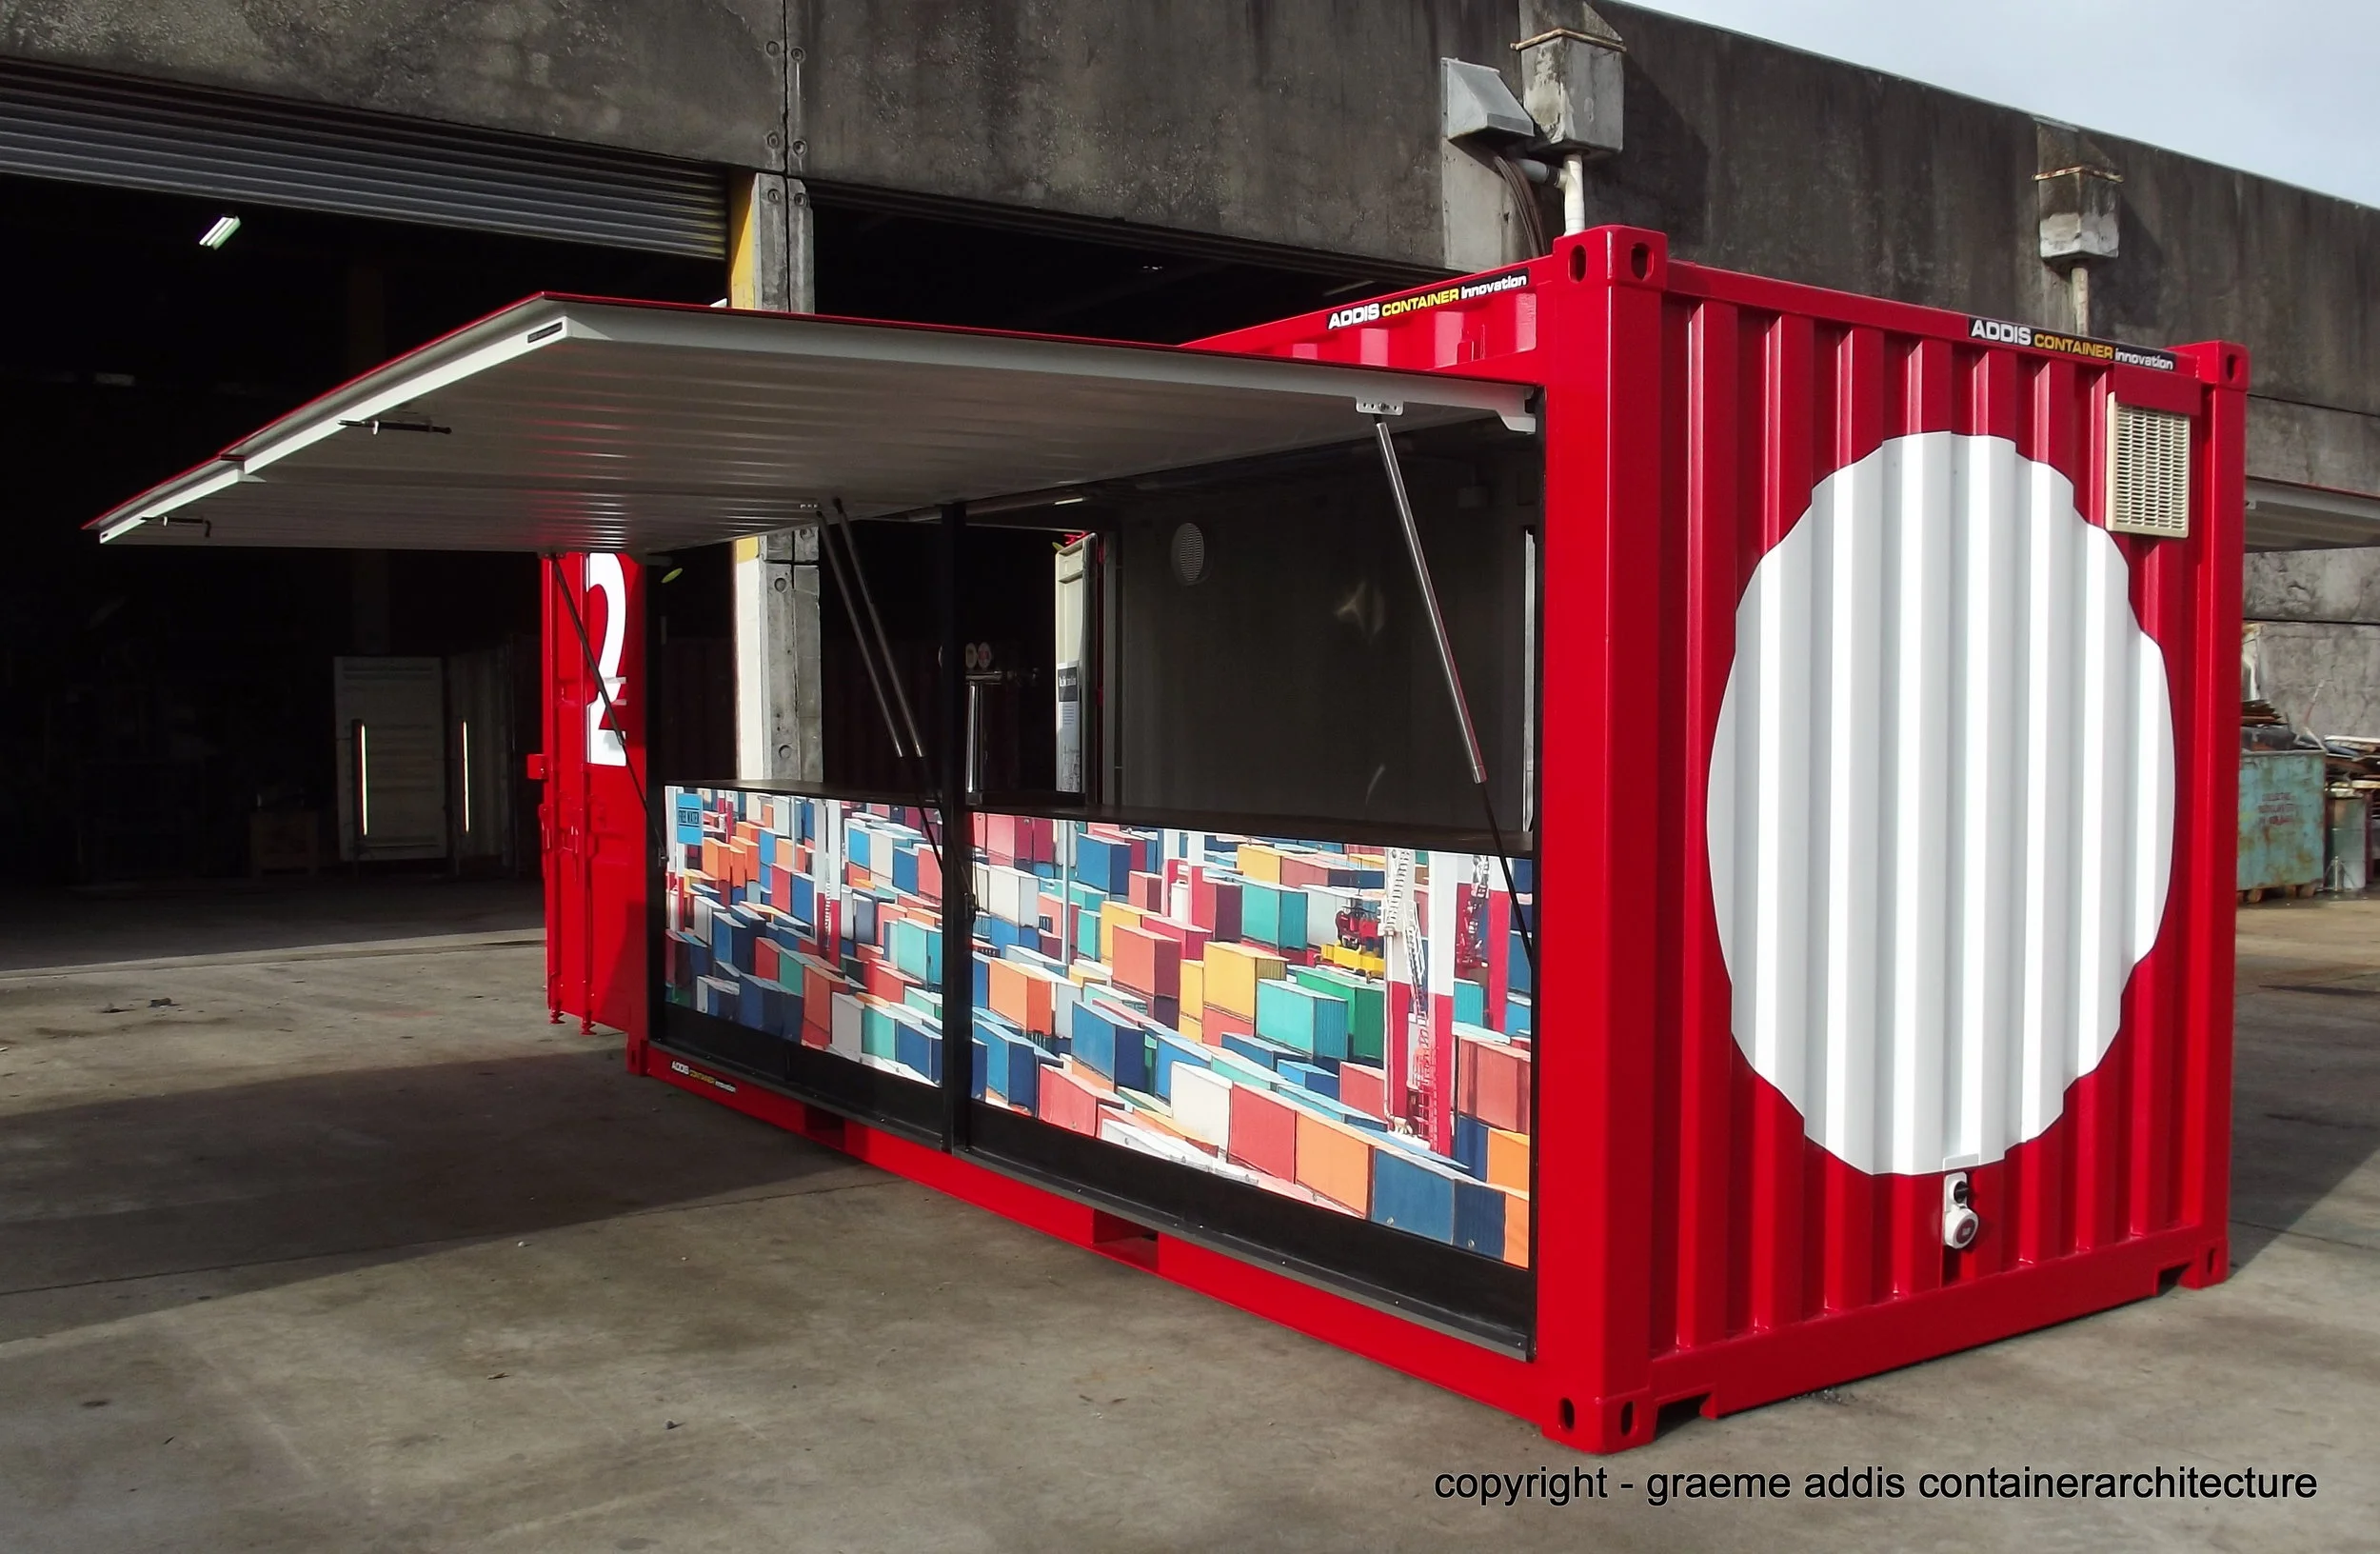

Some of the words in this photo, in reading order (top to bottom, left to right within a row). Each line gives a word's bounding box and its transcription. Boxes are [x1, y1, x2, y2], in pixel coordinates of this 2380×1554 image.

[1328, 303, 1379, 329] ADDIS
[1381, 289, 1458, 317] CONTAINER
[1460, 274, 1527, 299] innovation
[1971, 319, 2032, 346] ADDIS
[2033, 333, 2113, 360] CONTAINER
[2114, 349, 2173, 370] innovation
